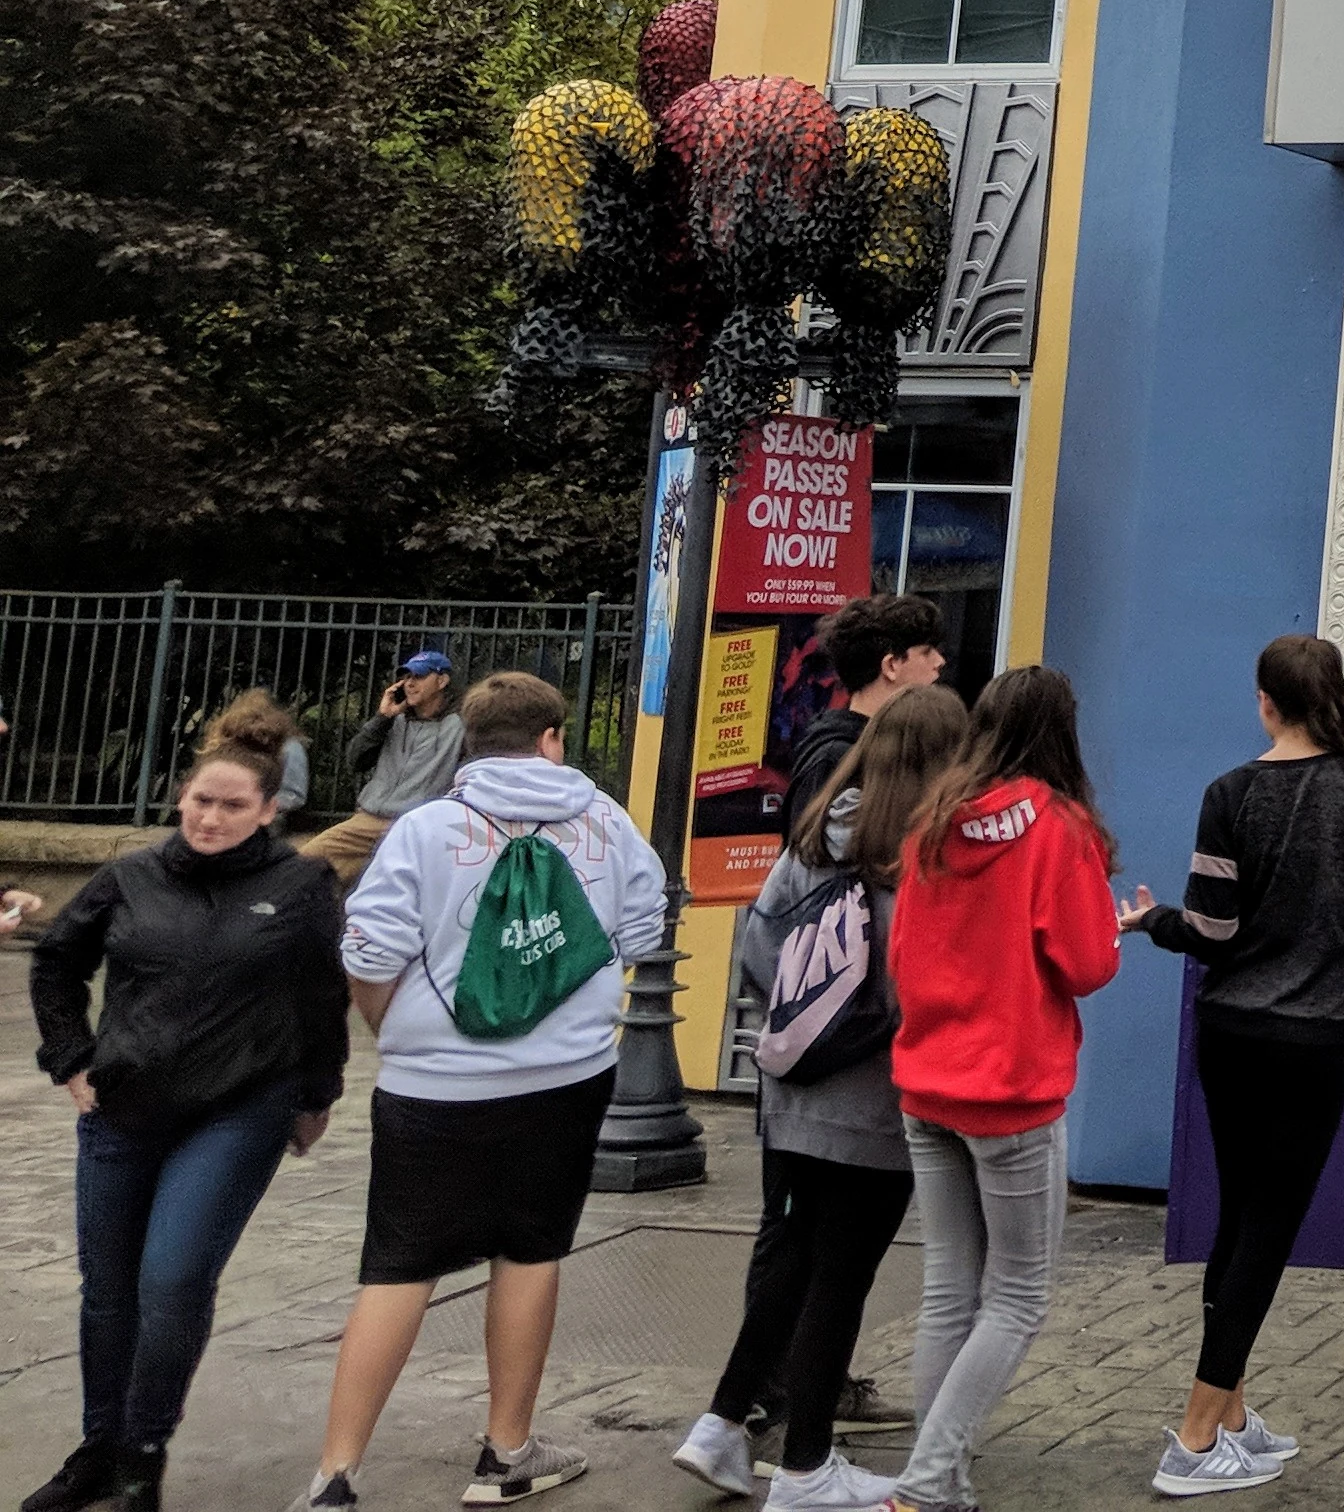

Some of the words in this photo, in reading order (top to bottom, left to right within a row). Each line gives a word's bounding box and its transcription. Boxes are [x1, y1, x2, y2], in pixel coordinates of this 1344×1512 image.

[761, 420, 858, 462] SEASON
[763, 458, 849, 497] PASSES
[747, 493, 793, 530] ON
[796, 497, 853, 534] SALE
[762, 533, 838, 569] NOW!
[764, 579, 787, 590] ONLY
[815, 580, 836, 592] WHEN
[746, 592, 768, 603] YOU
[785, 593, 809, 604] FOUR
[727, 639, 752, 653] FREE
[722, 673, 749, 688] FREE
[720, 699, 746, 714] FREE
[718, 725, 743, 740] FREE
[715, 739, 744, 750] HOLIDAY
[726, 859, 750, 870] AND
